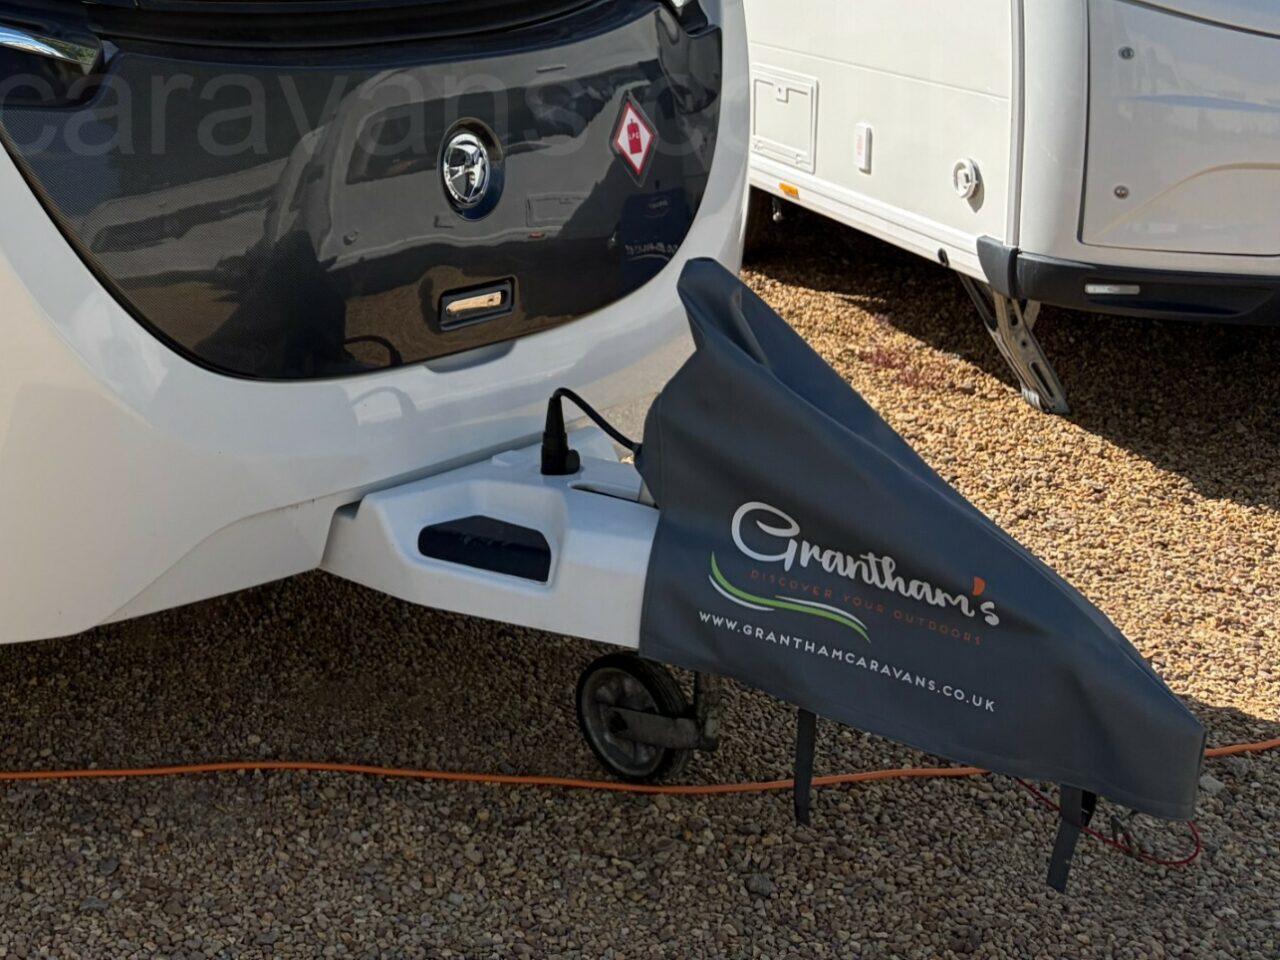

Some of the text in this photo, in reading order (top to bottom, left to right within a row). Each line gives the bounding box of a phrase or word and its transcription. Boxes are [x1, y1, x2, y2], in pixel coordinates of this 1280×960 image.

[731, 501, 1000, 626] Grantham's
[749, 569, 983, 646] DISCOVER YOUR OUTDOORS
[699, 611, 996, 713] WWW.GRANTHAMCARAVANS.CO.UK
